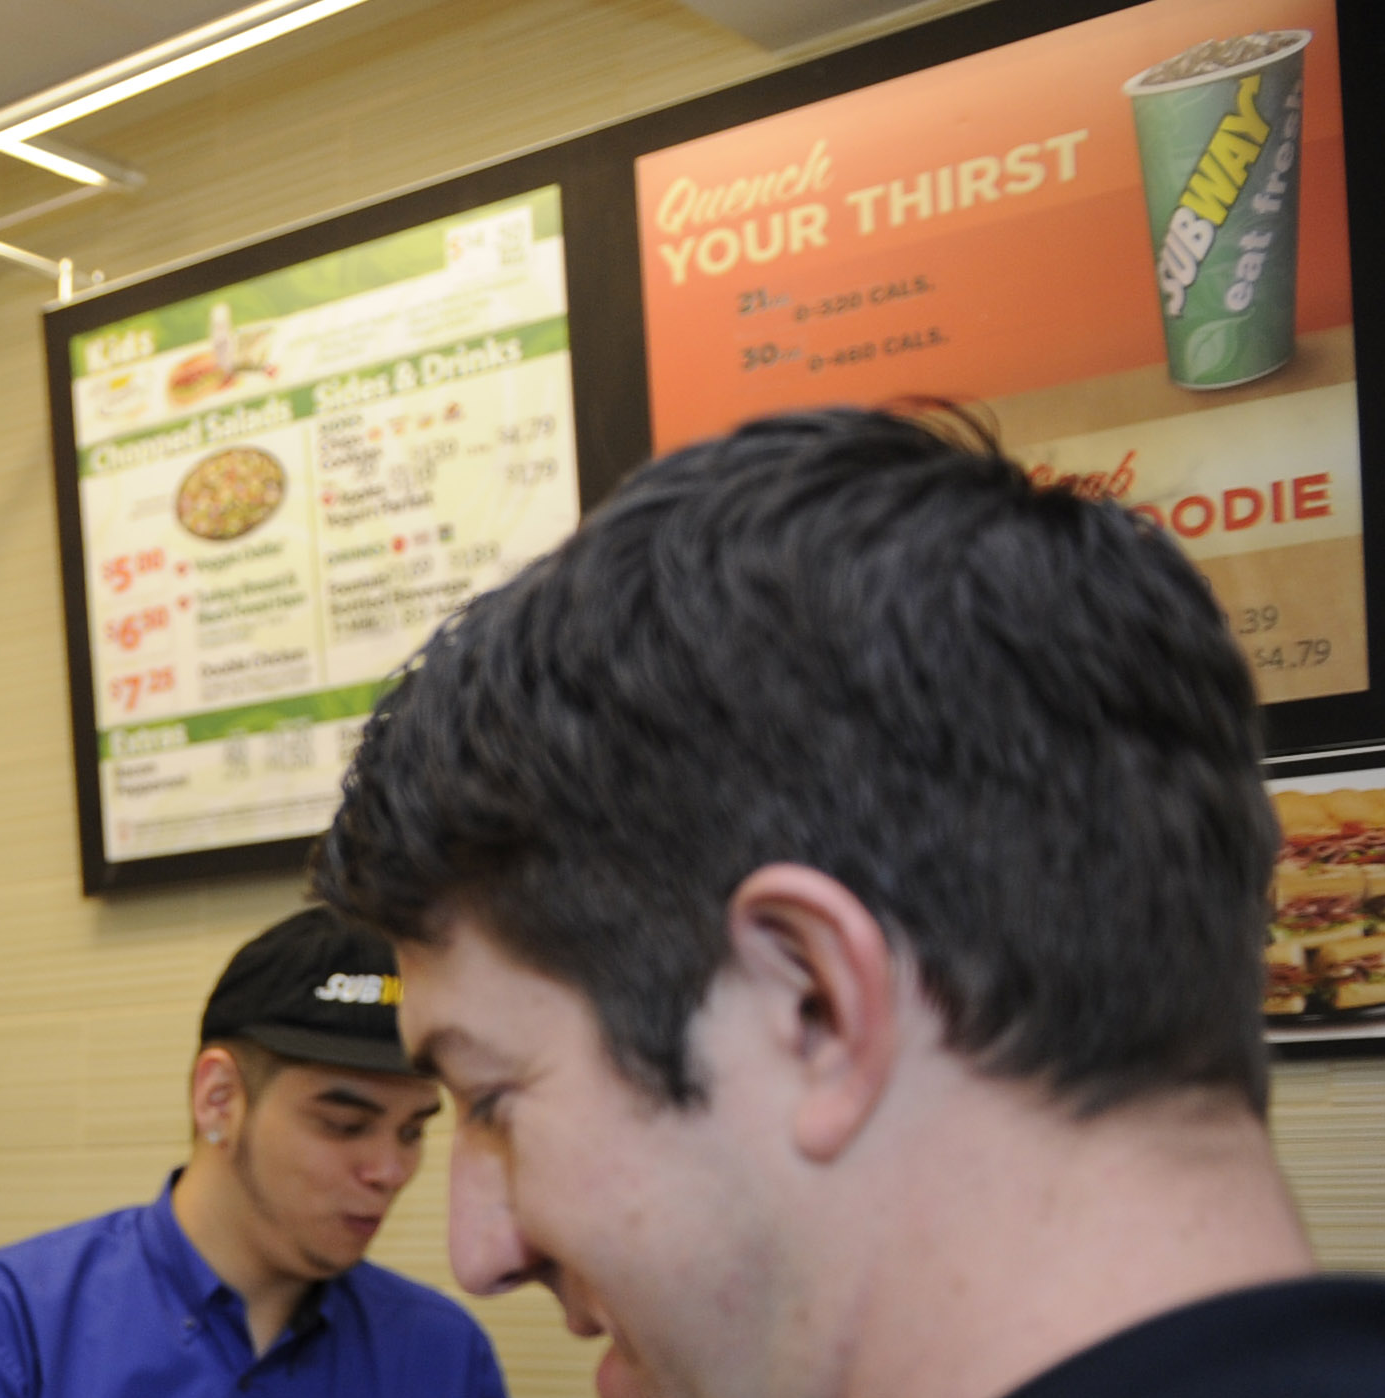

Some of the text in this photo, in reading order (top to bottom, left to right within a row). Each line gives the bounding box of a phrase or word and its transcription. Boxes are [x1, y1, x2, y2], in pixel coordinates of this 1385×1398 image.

[656, 138, 833, 234] Quench
[658, 129, 1089, 286] YOUR THIRST
[1159, 74, 1271, 319] SUBWAY
[1225, 229, 1274, 313] eat
